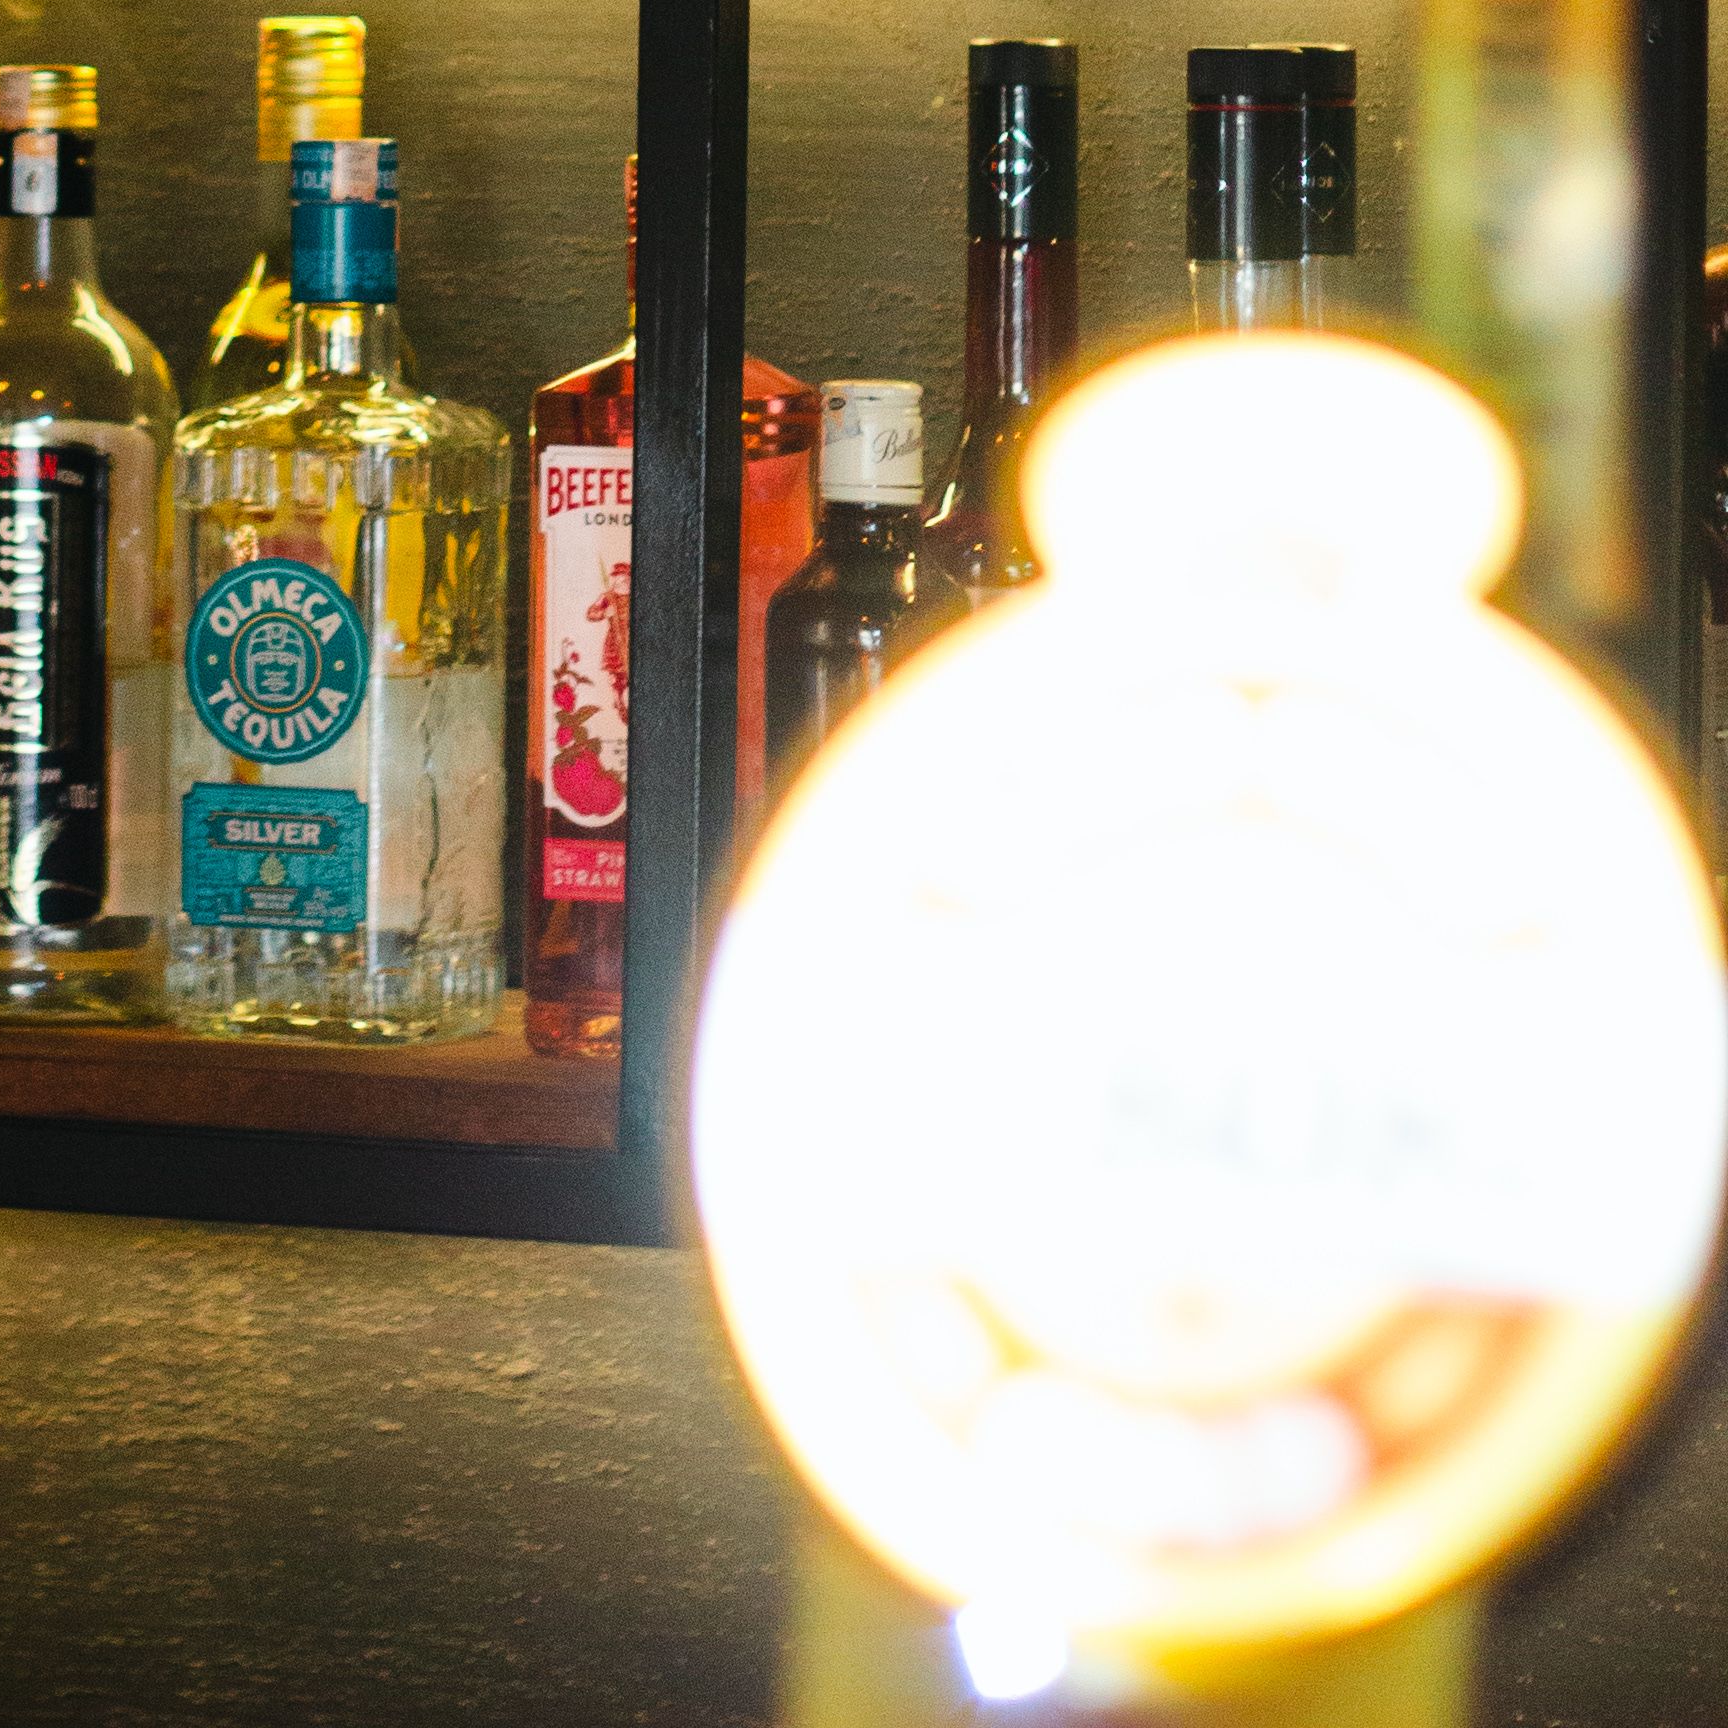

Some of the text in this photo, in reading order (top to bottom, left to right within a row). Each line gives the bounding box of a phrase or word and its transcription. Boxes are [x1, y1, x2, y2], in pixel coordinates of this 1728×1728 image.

[208, 577, 345, 645] OLMECA
[206, 677, 351, 750] TEQUILA
[224, 818, 323, 846] SILVER
